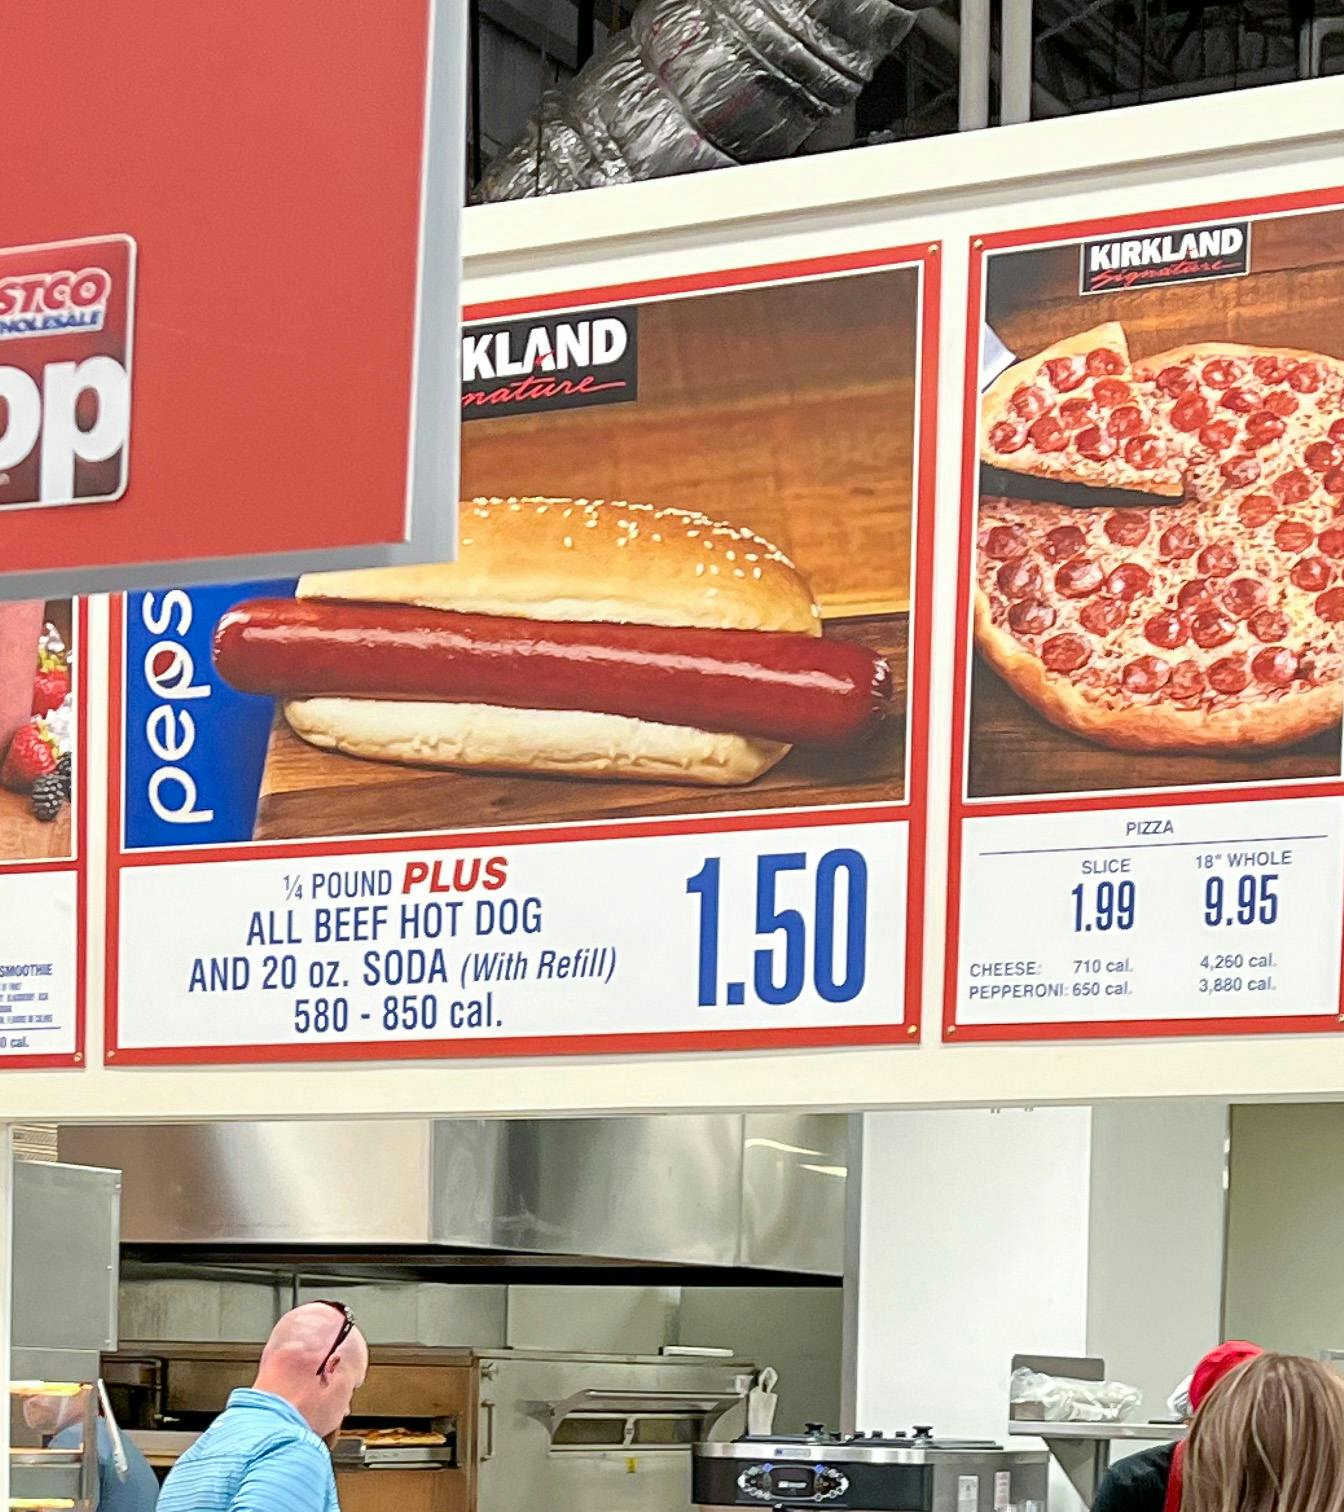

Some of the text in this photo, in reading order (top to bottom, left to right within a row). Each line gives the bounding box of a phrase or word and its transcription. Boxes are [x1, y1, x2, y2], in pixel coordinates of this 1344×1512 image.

[1090, 228, 1243, 271] KIRKLAND
[1090, 260, 1242, 291] Signature
[462, 317, 627, 381] KLAND
[462, 376, 627, 407] nature
[142, 589, 214, 824] peps
[1126, 820, 1174, 836] PIZZA
[312, 870, 393, 899] POUND
[402, 856, 509, 894] PLUS
[1082, 850, 1292, 874] SLICE 18" WHOLE
[246, 897, 542, 946] ALL BEEF HOT DOG
[1071, 873, 1279, 932] 1.99 9.95
[685, 848, 868, 1008] 1.50
[0, 963, 53, 977] SMOOTHIE
[189, 946, 617, 992] AND 20 oz. SODA (With Refill)
[969, 953, 1277, 977] CHEESE: 710 cal. 4,260 cal.
[969, 976, 1277, 1000] PEPPERONI: 650 cal. 3,880 cal.
[294, 998, 349, 1034] 580
[383, 994, 437, 1031] 850
[450, 991, 502, 1029] cal.
